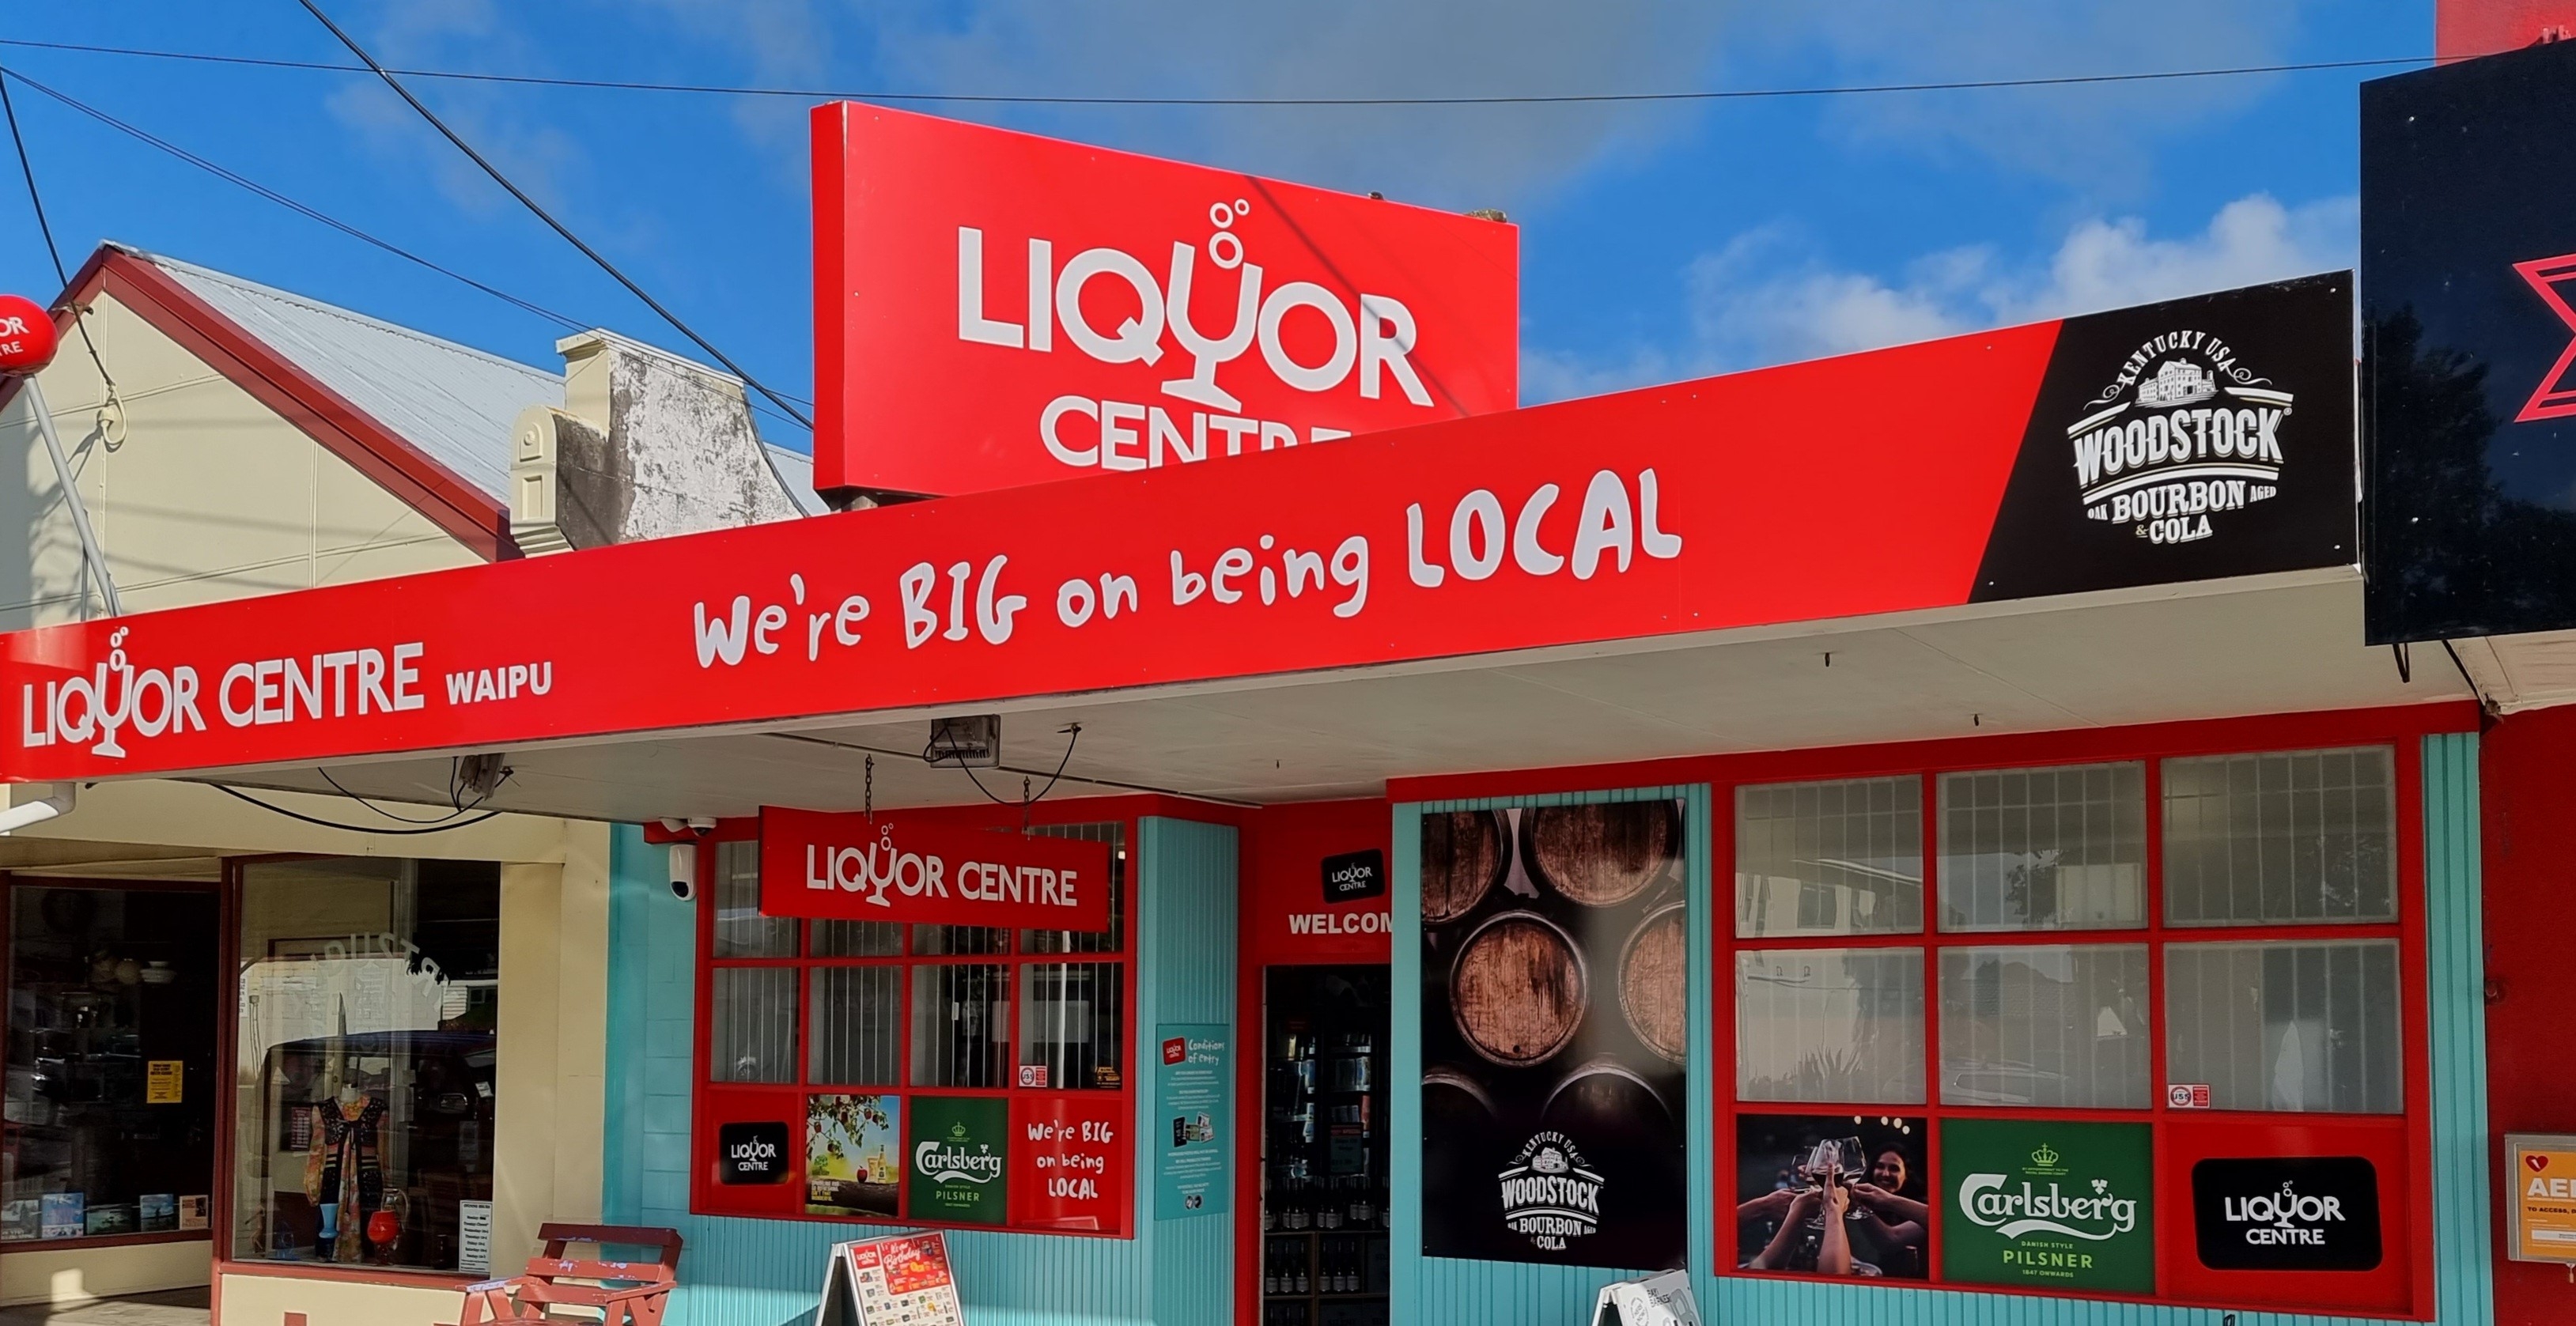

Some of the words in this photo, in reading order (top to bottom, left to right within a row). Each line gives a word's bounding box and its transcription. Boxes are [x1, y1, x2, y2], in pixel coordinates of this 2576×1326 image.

[959, 225, 1434, 414] LIQUOR
[2116, 331, 2206, 386] KENTUCKY
[2205, 337, 2237, 372] USA
[1040, 395, 1352, 472] CENT
[2073, 407, 2284, 489] WOODSTOCK
[2087, 504, 2109, 521] OAK
[2112, 480, 2246, 524] BOURBON
[2249, 485, 2277, 503] AGED
[2135, 524, 2149, 538] &
[2149, 514, 2213, 544] COLA
[23, 663, 206, 758] LIQUOR
[219, 642, 425, 727] CENTRE
[445, 662, 552, 706] WAIPU
[694, 573, 871, 668] We're
[899, 554, 1027, 649] BIG
[1057, 572, 1138, 628] on
[1170, 534, 1369, 618] being
[1406, 467, 1682, 587] LOCAL
[807, 841, 949, 907] LIQUOR
[957, 861, 1078, 907] CENTRE
[1332, 867, 1373, 882] LIQUOR
[1339, 881, 1367, 891] CENTRE
[1288, 912, 1392, 935] WELCOM
[1188, 1052, 1197, 1063] of
[1027, 1119, 1075, 1143] We're
[1082, 1120, 1114, 1144] BIG
[731, 1142, 777, 1162] LIQUOR
[1523, 1131, 1564, 1157] KENTUCKY
[1564, 1139, 1578, 1158] USA
[738, 1162, 769, 1171] CENTRE
[916, 1141, 1002, 1181] Carlsberg
[1037, 1156, 1055, 1169] on
[1061, 1153, 1104, 1175] being
[936, 1191, 980, 1201] PILSNER
[1048, 1177, 1099, 1200] LOCAL
[1501, 1176, 1599, 1215] WOODSTOCK
[1959, 1173, 2137, 1237] Carlsberg
[2225, 1192, 2346, 1228] LIQUOR
[1519, 1216, 1582, 1237] BOURBON
[2245, 1229, 2325, 1245] CENTRE
[1537, 1235, 1567, 1250] COLA
[2003, 1250, 2093, 1269] PILSNER
